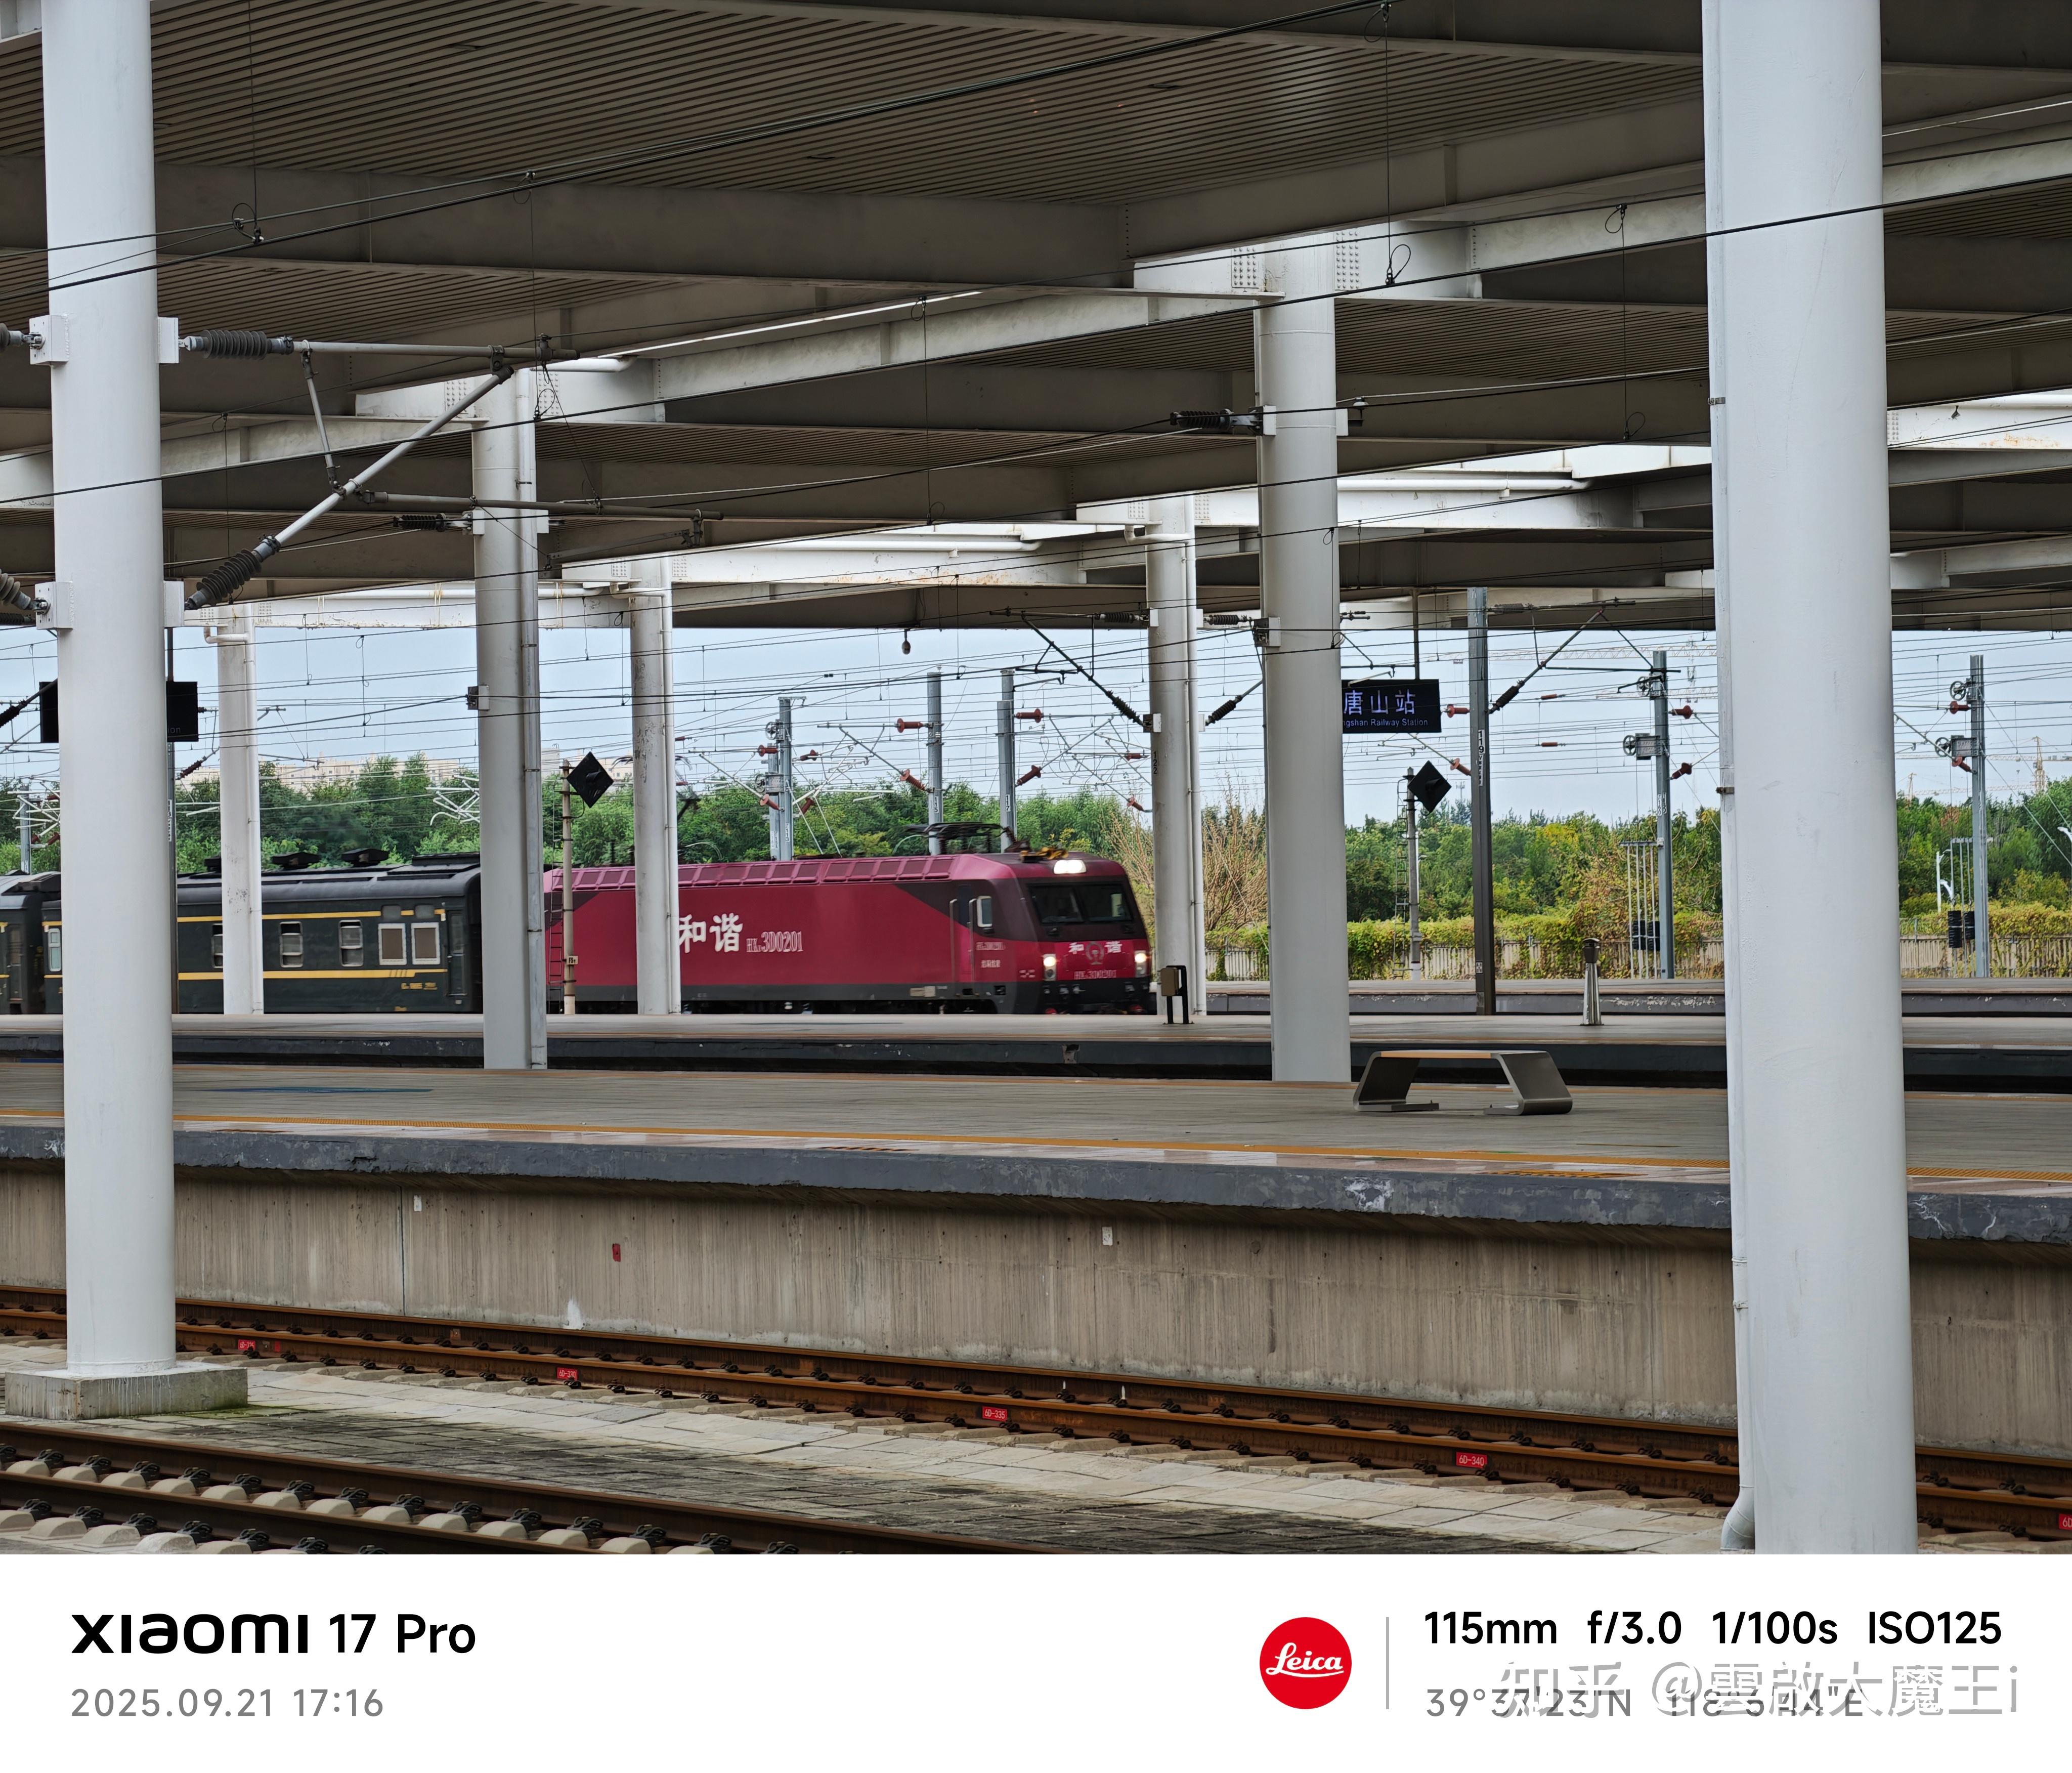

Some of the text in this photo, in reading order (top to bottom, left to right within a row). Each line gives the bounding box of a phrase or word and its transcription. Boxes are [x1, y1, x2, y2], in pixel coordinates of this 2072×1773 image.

[1344, 689, 1415, 715] 唐山站
[1371, 719, 1400, 728] Railway
[679, 913, 743, 953] 和谐
